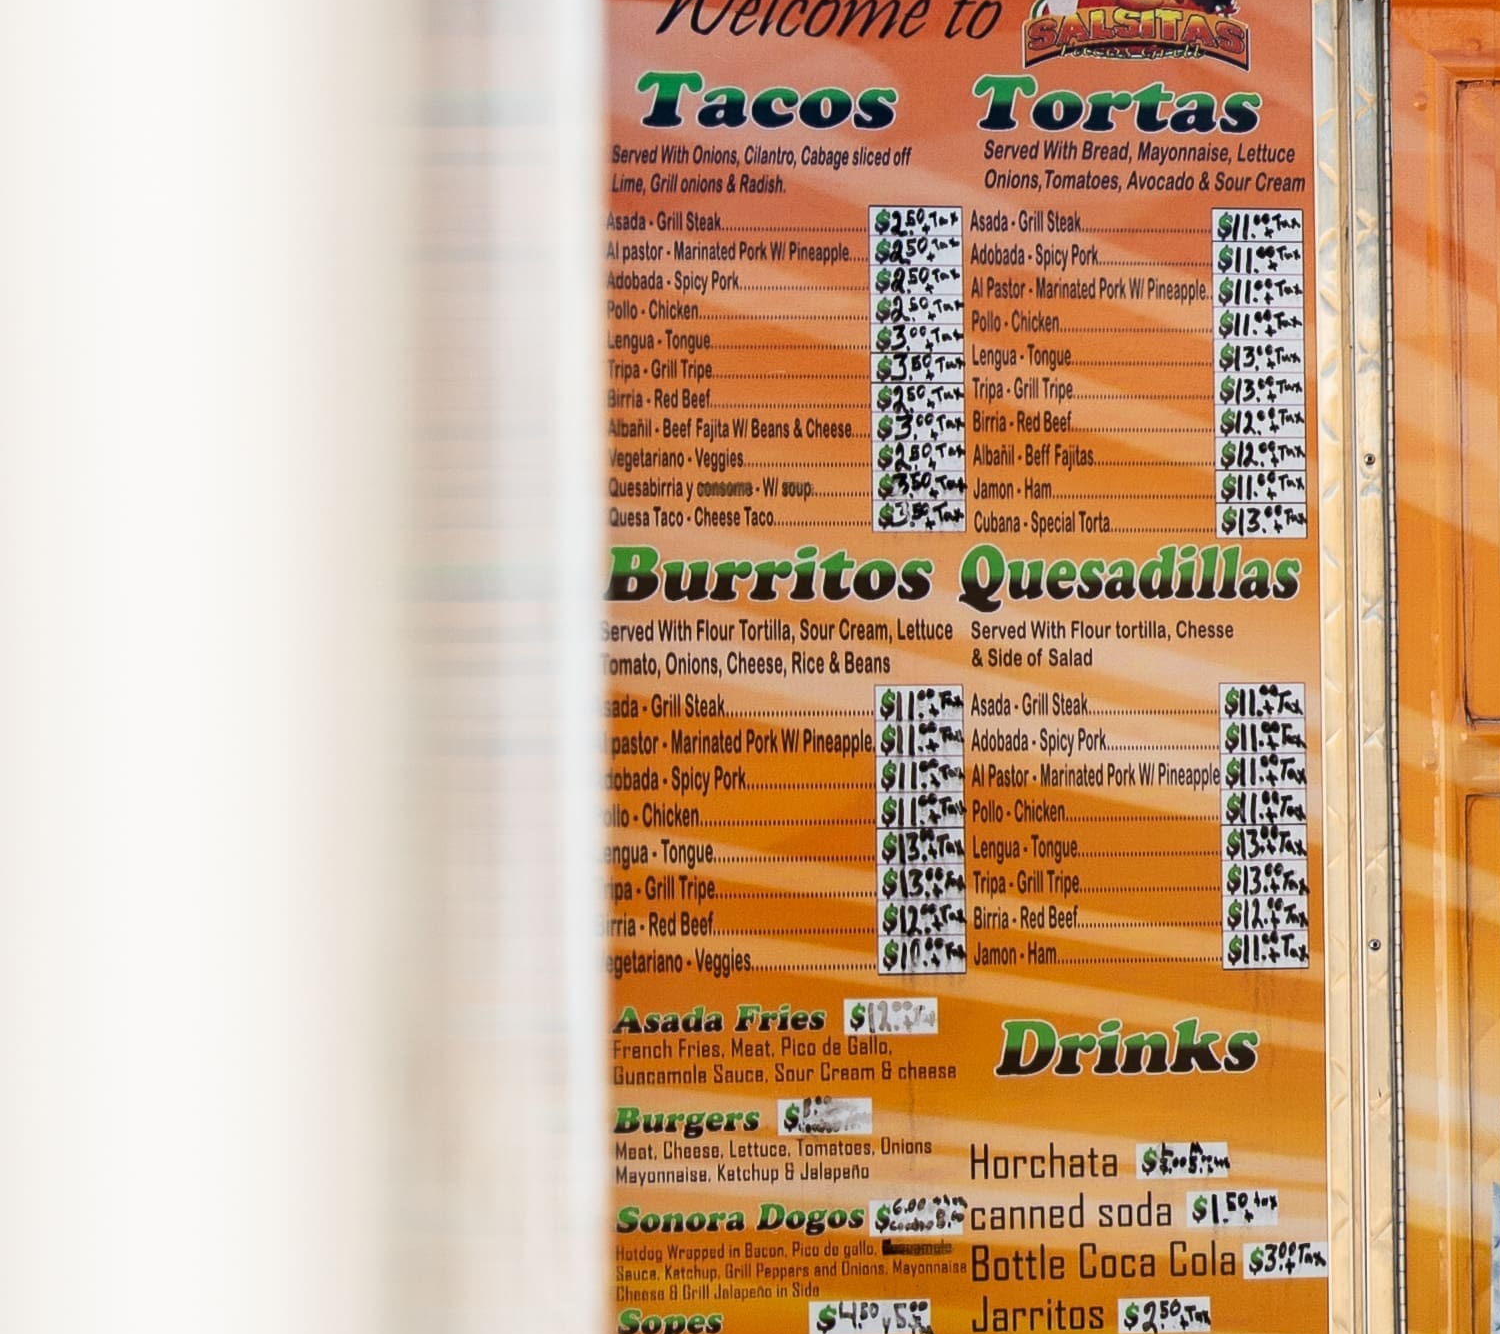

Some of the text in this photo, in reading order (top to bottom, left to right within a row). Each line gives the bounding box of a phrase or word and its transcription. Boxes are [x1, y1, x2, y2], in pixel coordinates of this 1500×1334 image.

[1027, 8, 1245, 55] SALSITAS
[637, 71, 897, 130] Tacos
[972, 75, 1261, 133] Tortas
[612, 144, 912, 171] Served With Onions, Cilantro, Cabage sliced off
[984, 139, 1295, 166] Served With Bread, Mayonnaise, Lettuce
[612, 173, 786, 195] Lime, Grill onions & Radish.
[1126, 171, 1194, 191] Avocado
[1199, 171, 1210, 191] &
[1214, 171, 1252, 192] Sour
[1255, 172, 1305, 192] Cream
[970, 209, 1008, 232] Asada
[1018, 210, 1043, 232] Grill
[970, 243, 1025, 266] Adobada
[1035, 243, 1068, 269] Spicy
[972, 310, 1001, 332] Pollo
[973, 410, 1006, 432] Birria
[1017, 410, 1040, 433] Red
[973, 444, 1014, 466] Albañil
[1025, 443, 1050, 466] Beff
[974, 510, 1020, 533] Cubana
[1031, 510, 1075, 537] Special
[605, 545, 933, 602] Burritos
[958, 544, 1300, 612] Quesadillas
[658, 619, 692, 642] With
[697, 619, 735, 641] Flour
[739, 619, 795, 645] Tortilla,
[800, 618, 835, 641] Sour
[839, 618, 892, 644] Cream,
[897, 618, 953, 640] Lettuce
[971, 620, 1234, 641] Served With Flour tortilla, Chesse
[972, 648, 1092, 667] & Side of Salad
[973, 870, 1006, 899] Tripa
[1017, 870, 1043, 894] Grill
[974, 942, 1016, 966] Jamon
[613, 1004, 827, 1035] Asada Fries
[995, 1018, 1261, 1078] Drinks
[613, 1105, 760, 1138] Burgers
[970, 1142, 1118, 1180] Horchata
[616, 1202, 865, 1238] Sonora Dogos
[971, 1192, 1084, 1231] canned
[1099, 1191, 1171, 1227] soda
[971, 1244, 1065, 1282] Bottle
[1079, 1243, 1155, 1279] Coca
[1170, 1240, 1236, 1277] Cola
[972, 1296, 1104, 1332] Jarritos
